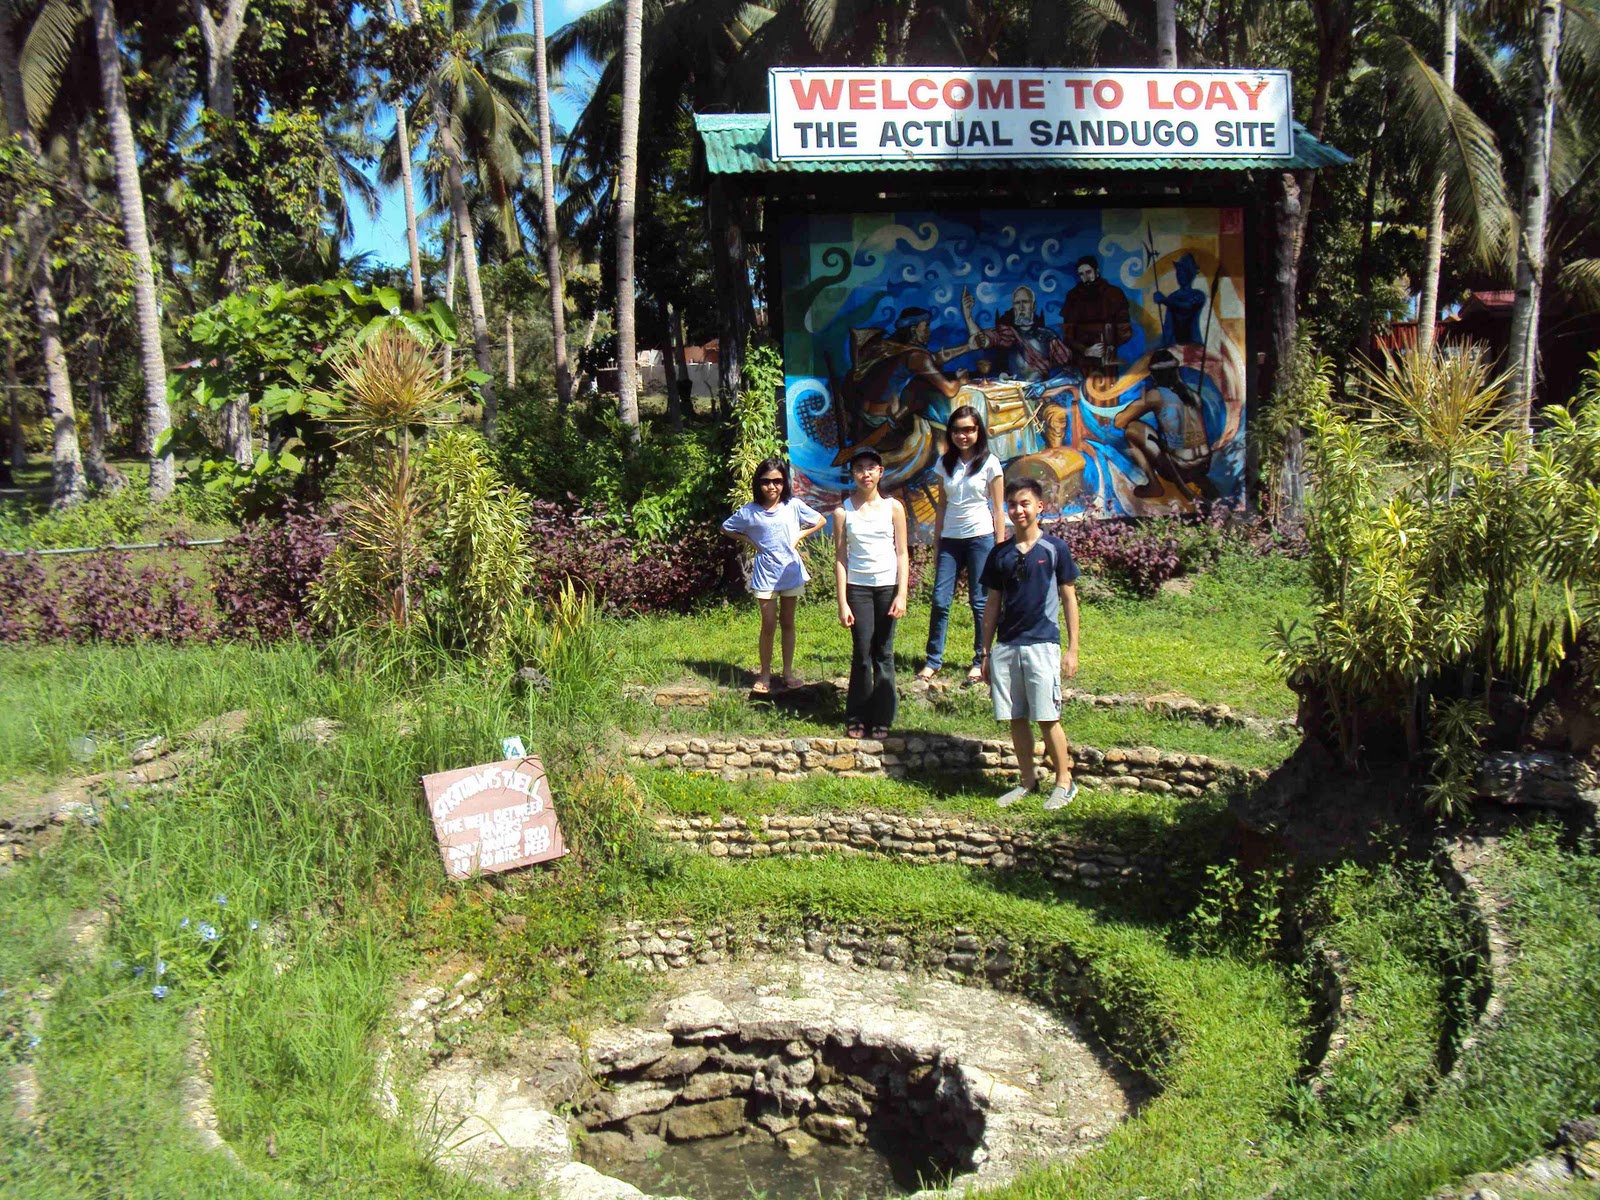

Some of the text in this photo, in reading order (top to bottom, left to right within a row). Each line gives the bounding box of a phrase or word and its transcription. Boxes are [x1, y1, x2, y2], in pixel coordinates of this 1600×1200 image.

[789, 78, 1270, 111] WELCOME TO LOAY
[793, 120, 1276, 148] THE ACTUAL SANDUGO SITE
